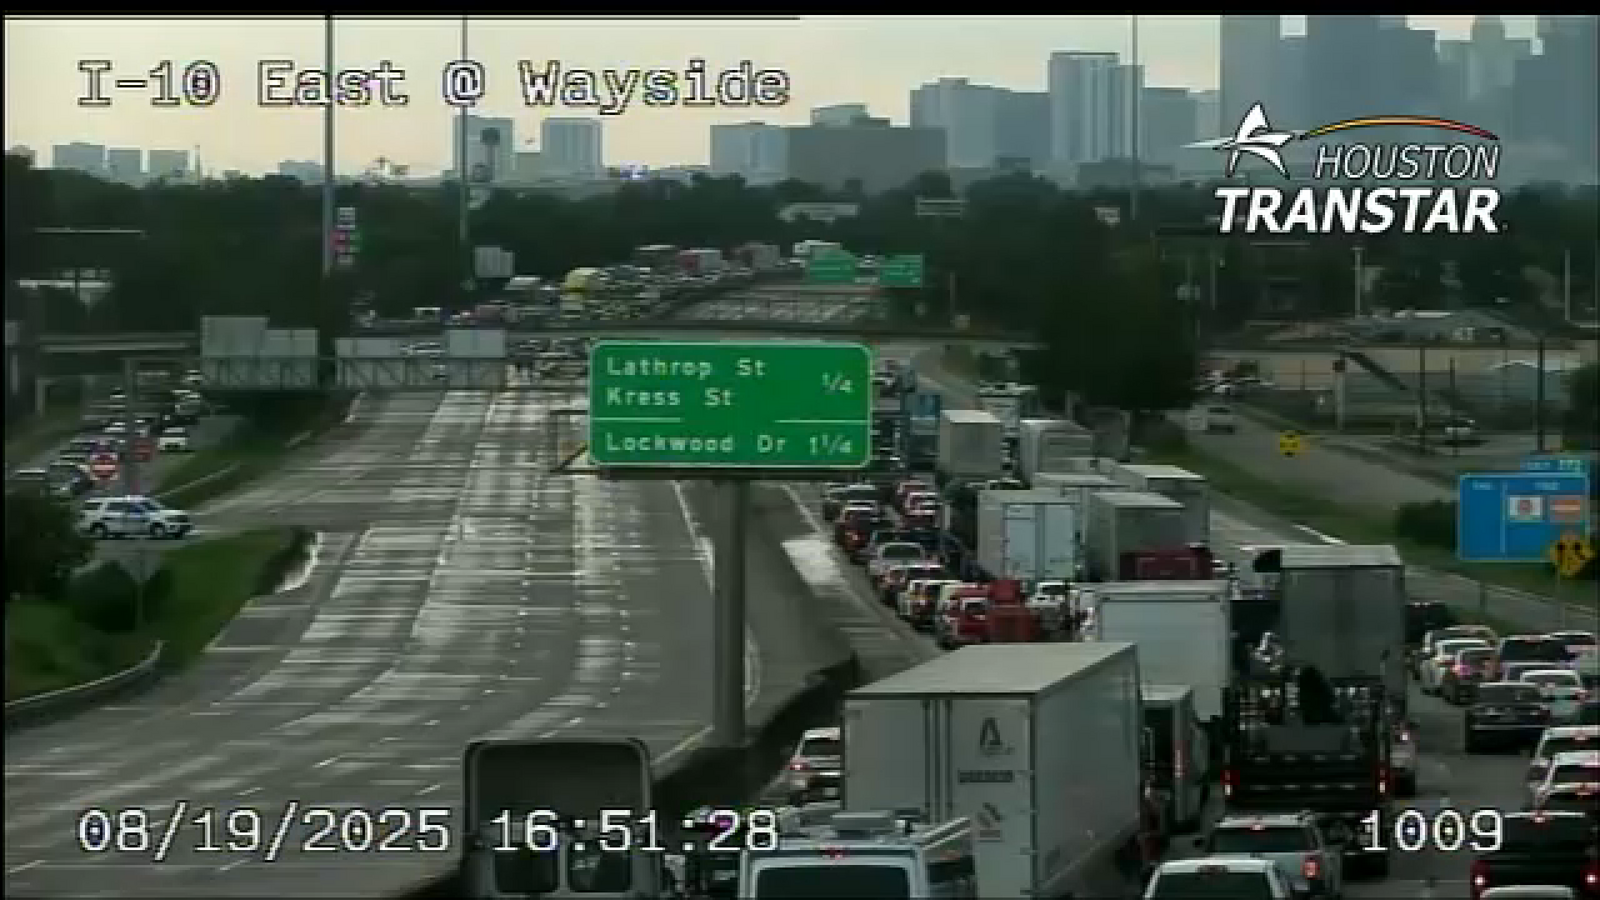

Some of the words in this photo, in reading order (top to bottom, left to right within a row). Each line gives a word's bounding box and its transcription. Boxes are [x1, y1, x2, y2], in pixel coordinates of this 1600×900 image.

[606, 356, 713, 380] Lathrop
[736, 357, 767, 376] St
[606, 387, 681, 406] Kress
[704, 388, 732, 406] St
[606, 432, 735, 453] Lockwood
[757, 434, 787, 453] Dr
